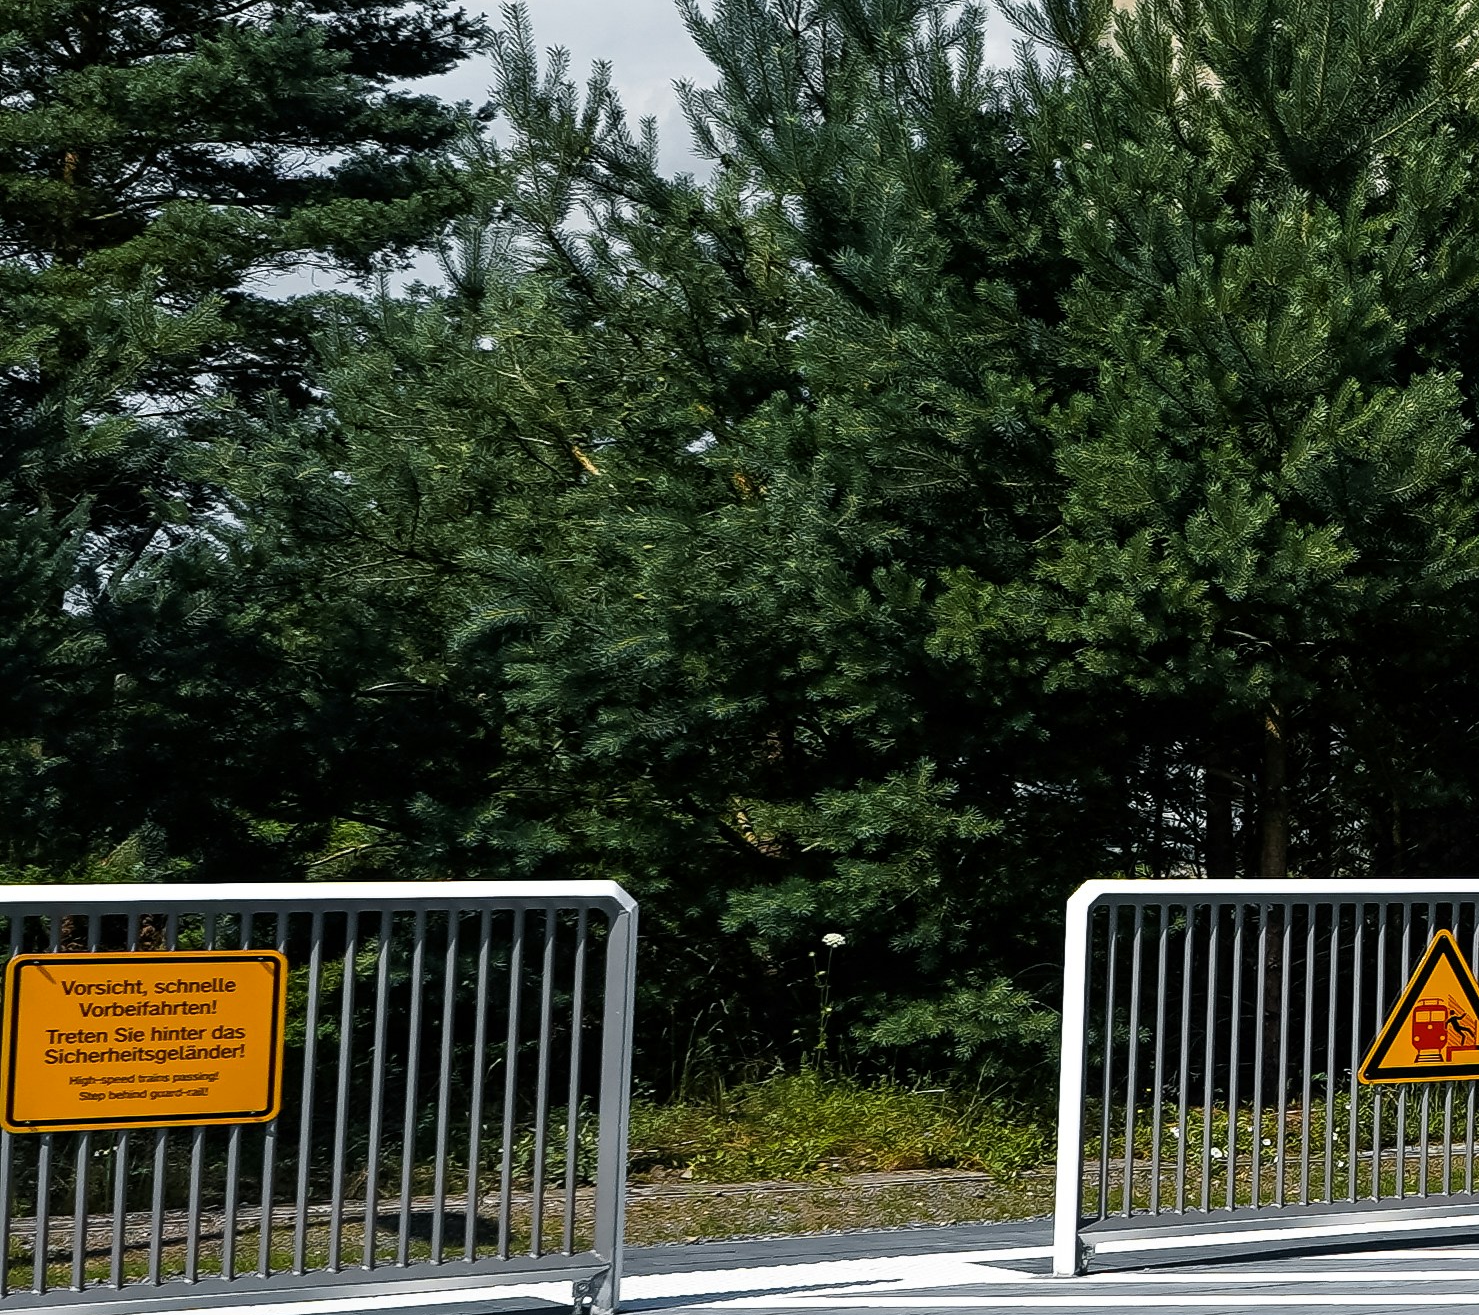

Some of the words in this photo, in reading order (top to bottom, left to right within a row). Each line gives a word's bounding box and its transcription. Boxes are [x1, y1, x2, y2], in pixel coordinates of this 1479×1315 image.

[61, 979, 148, 997] Vorsicht,
[154, 977, 236, 994] schnelle
[79, 999, 218, 1018] Vorbeifahrten!
[45, 1028, 108, 1045] Treten
[114, 1026, 146, 1043] Sie
[150, 1025, 207, 1042] hinter
[211, 1024, 246, 1040] das
[44, 1044, 246, 1065] Sicherheitsgeländer!
[69, 1073, 136, 1087] High-speed
[138, 1072, 170, 1084] trains
[172, 1071, 220, 1085] passing!
[78, 1090, 105, 1103] Step
[108, 1089, 147, 1101] behind
